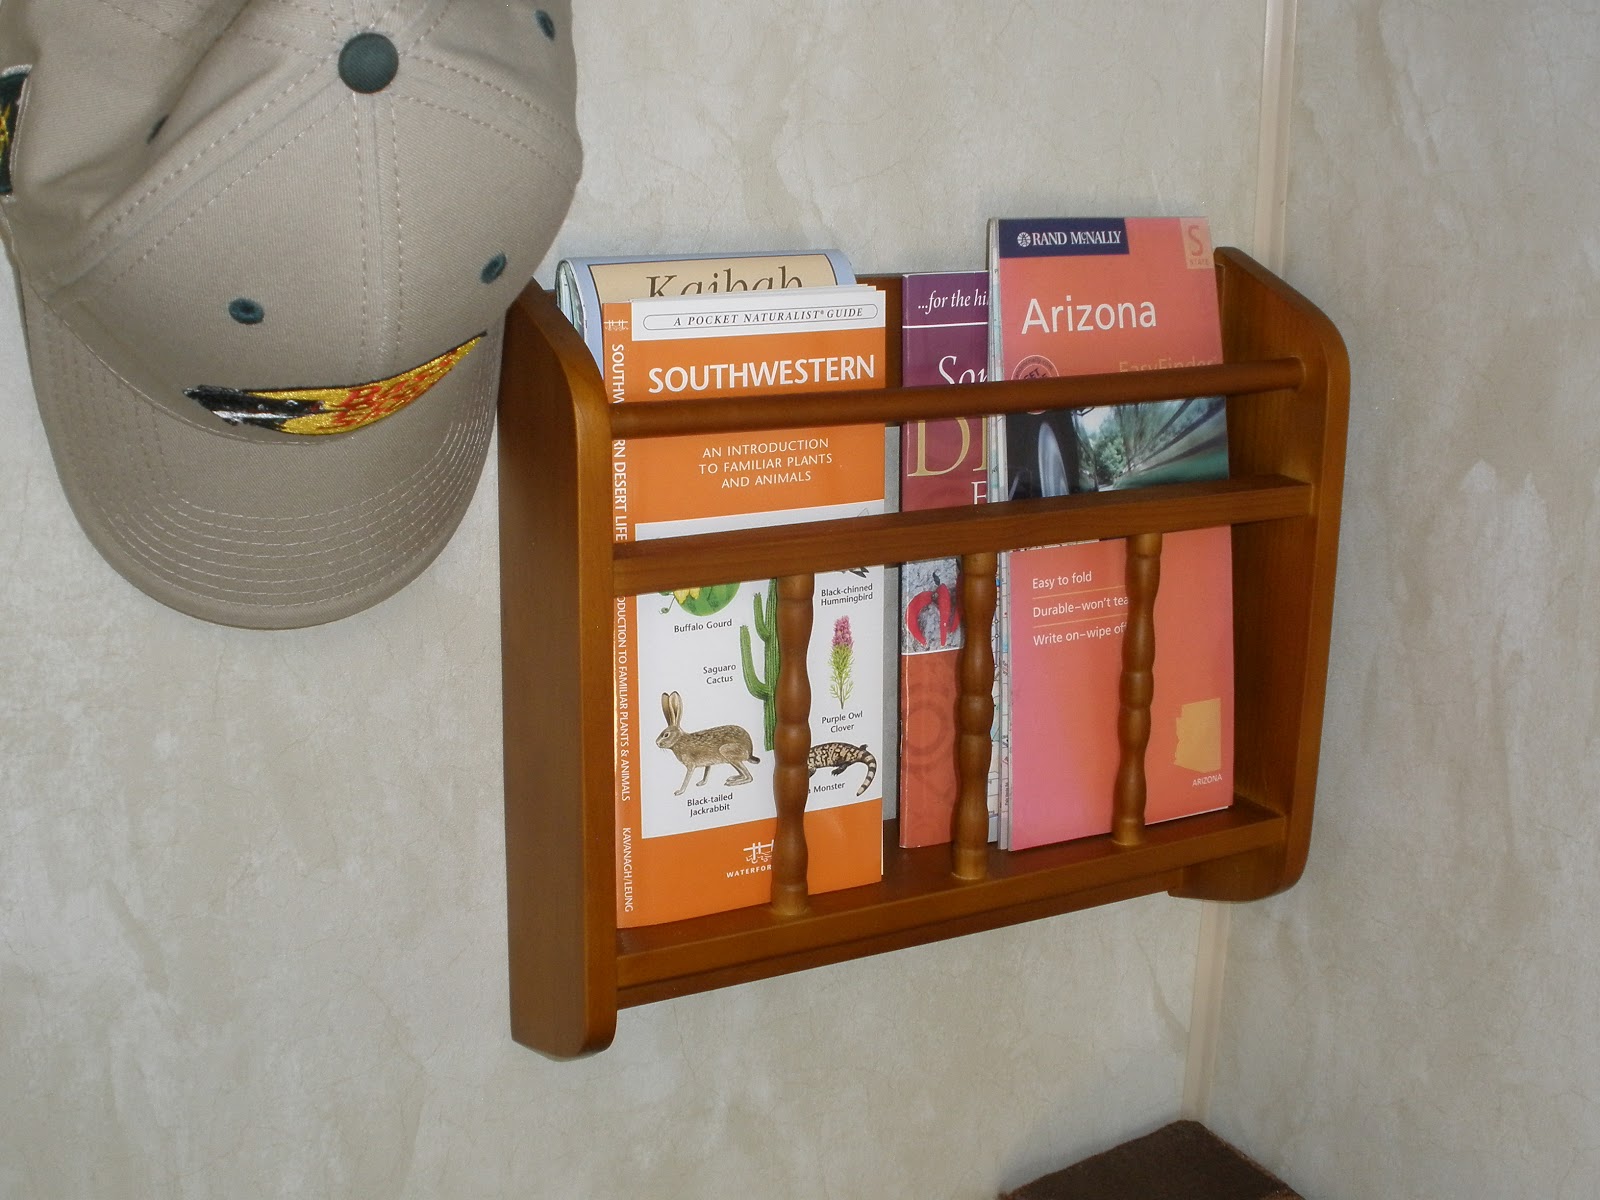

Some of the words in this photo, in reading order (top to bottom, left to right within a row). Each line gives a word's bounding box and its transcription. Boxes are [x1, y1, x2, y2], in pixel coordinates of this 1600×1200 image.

[1032, 232, 1067, 246] RAND
[1188, 225, 1203, 256] S
[951, 289, 970, 308] the
[974, 288, 988, 306] hi
[674, 317, 681, 327] A
[688, 314, 738, 326] POCKET
[827, 307, 863, 318] GUIDE
[1021, 295, 1157, 334] Arizona
[648, 354, 875, 393] SOUTHWESTERN
[703, 446, 722, 458] AN
[727, 438, 829, 457] INTRODUCTION
[699, 463, 718, 475] TO
[724, 457, 782, 473] FAMILIAR
[787, 453, 833, 468] PLANTS
[721, 476, 750, 489] AND
[754, 470, 812, 486] ANIMALS
[614, 462, 627, 513] DESERT
[615, 515, 628, 542] LIFE
[1032, 578, 1055, 589] Easy
[1057, 576, 1069, 586] to
[1072, 571, 1092, 584] fold
[821, 583, 873, 596] Black-chinned
[821, 592, 873, 606] Hummingbird
[1114, 596, 1129, 607] tea
[674, 623, 704, 633] Buffalo
[706, 619, 733, 629] Gourd
[1033, 632, 1063, 646] Write
[618, 649, 628, 664] TO
[703, 664, 737, 675] Saguaro
[706, 675, 734, 685] Cactus
[618, 667, 628, 710] FAMILIAR
[821, 713, 846, 724] Purple
[848, 710, 863, 720] Owl
[619, 712, 629, 747] PLANTS
[830, 724, 855, 733] Clover
[620, 749, 629, 757] &
[621, 759, 631, 802] ANIMALS
[813, 782, 846, 793] Monster
[1192, 773, 1223, 787] ARIZONA
[687, 792, 733, 807] Black-tailed
[690, 803, 731, 818] Jackrabbit
[622, 827, 634, 912] KAVANAGH/LEUNG
[726, 864, 772, 879] WATERFOR
